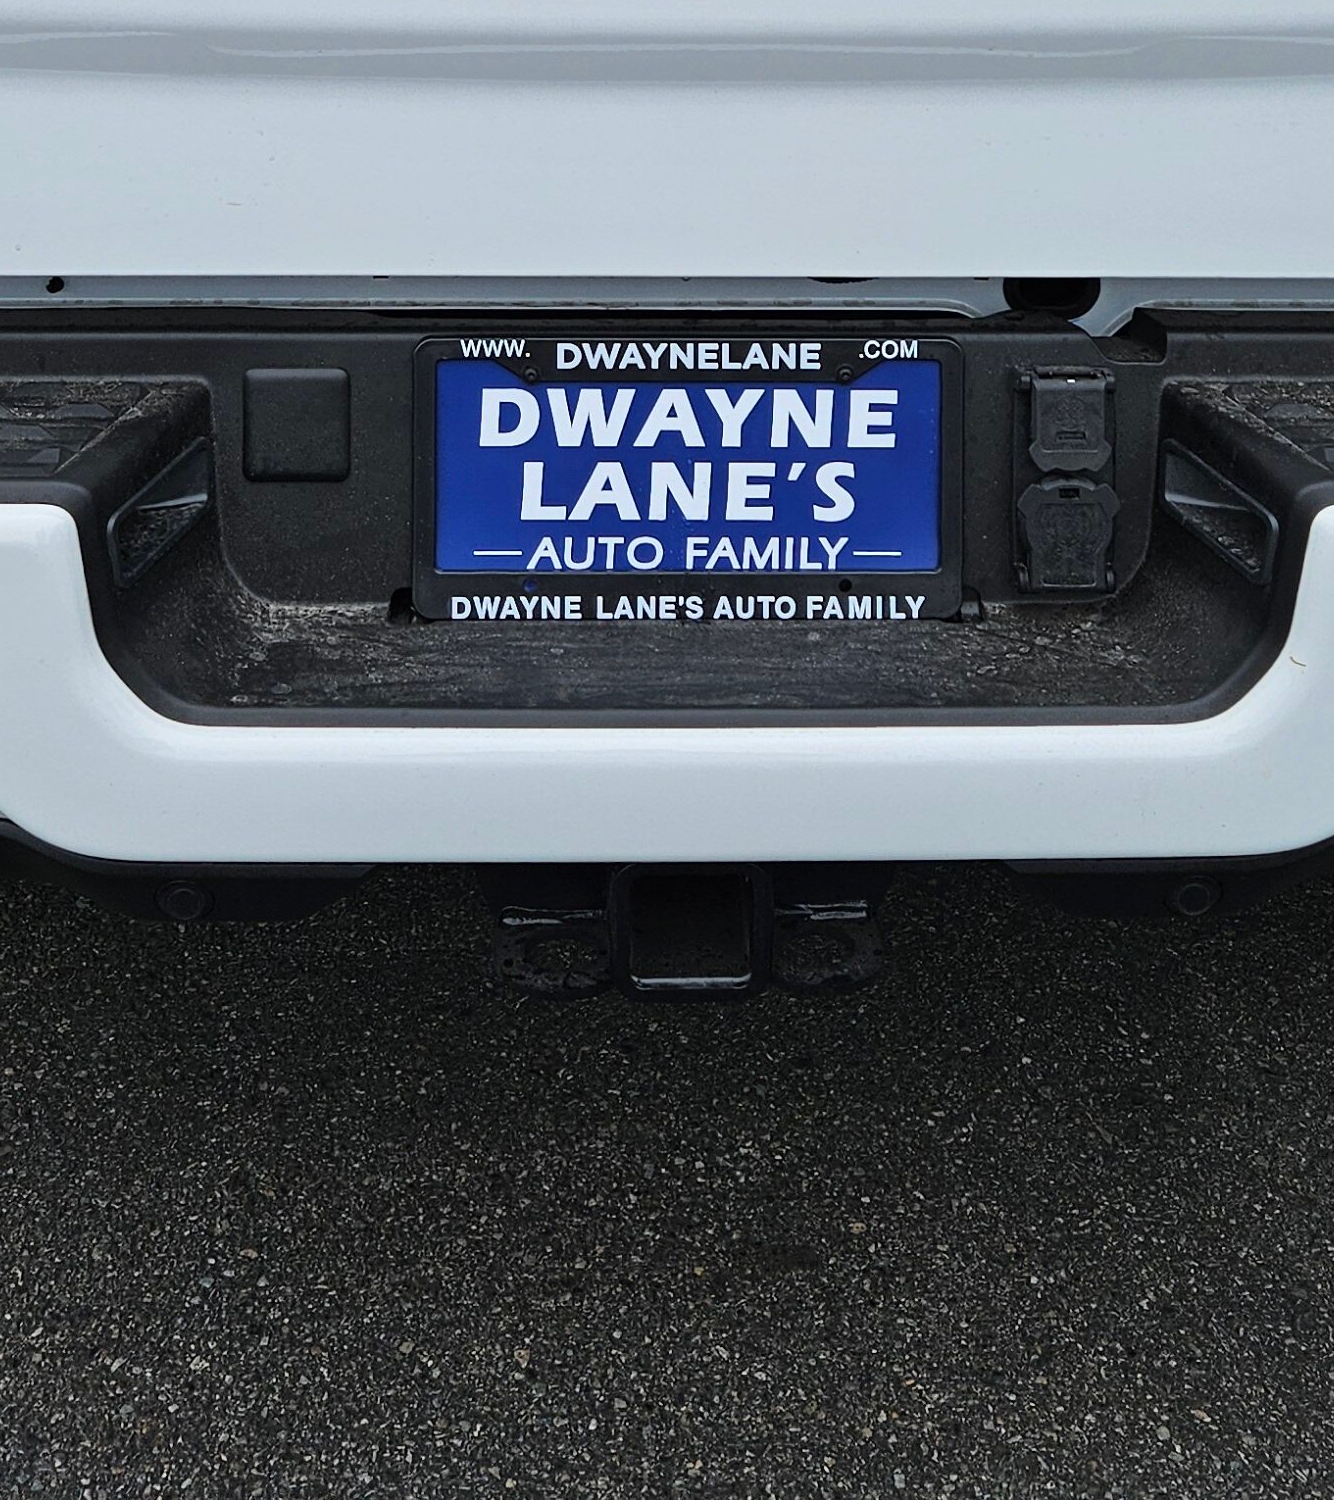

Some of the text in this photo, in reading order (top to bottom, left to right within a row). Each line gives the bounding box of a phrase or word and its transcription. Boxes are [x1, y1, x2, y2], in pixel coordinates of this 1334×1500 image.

[460, 339, 919, 370] WWW. DWAYNELANE .COM
[479, 387, 899, 448] DWAYNE
[520, 461, 856, 523] LANE'S
[526, 536, 849, 570] AUTO FAMILY
[451, 595, 926, 620] DWAYNE LANE'S AUTO FAMILY
